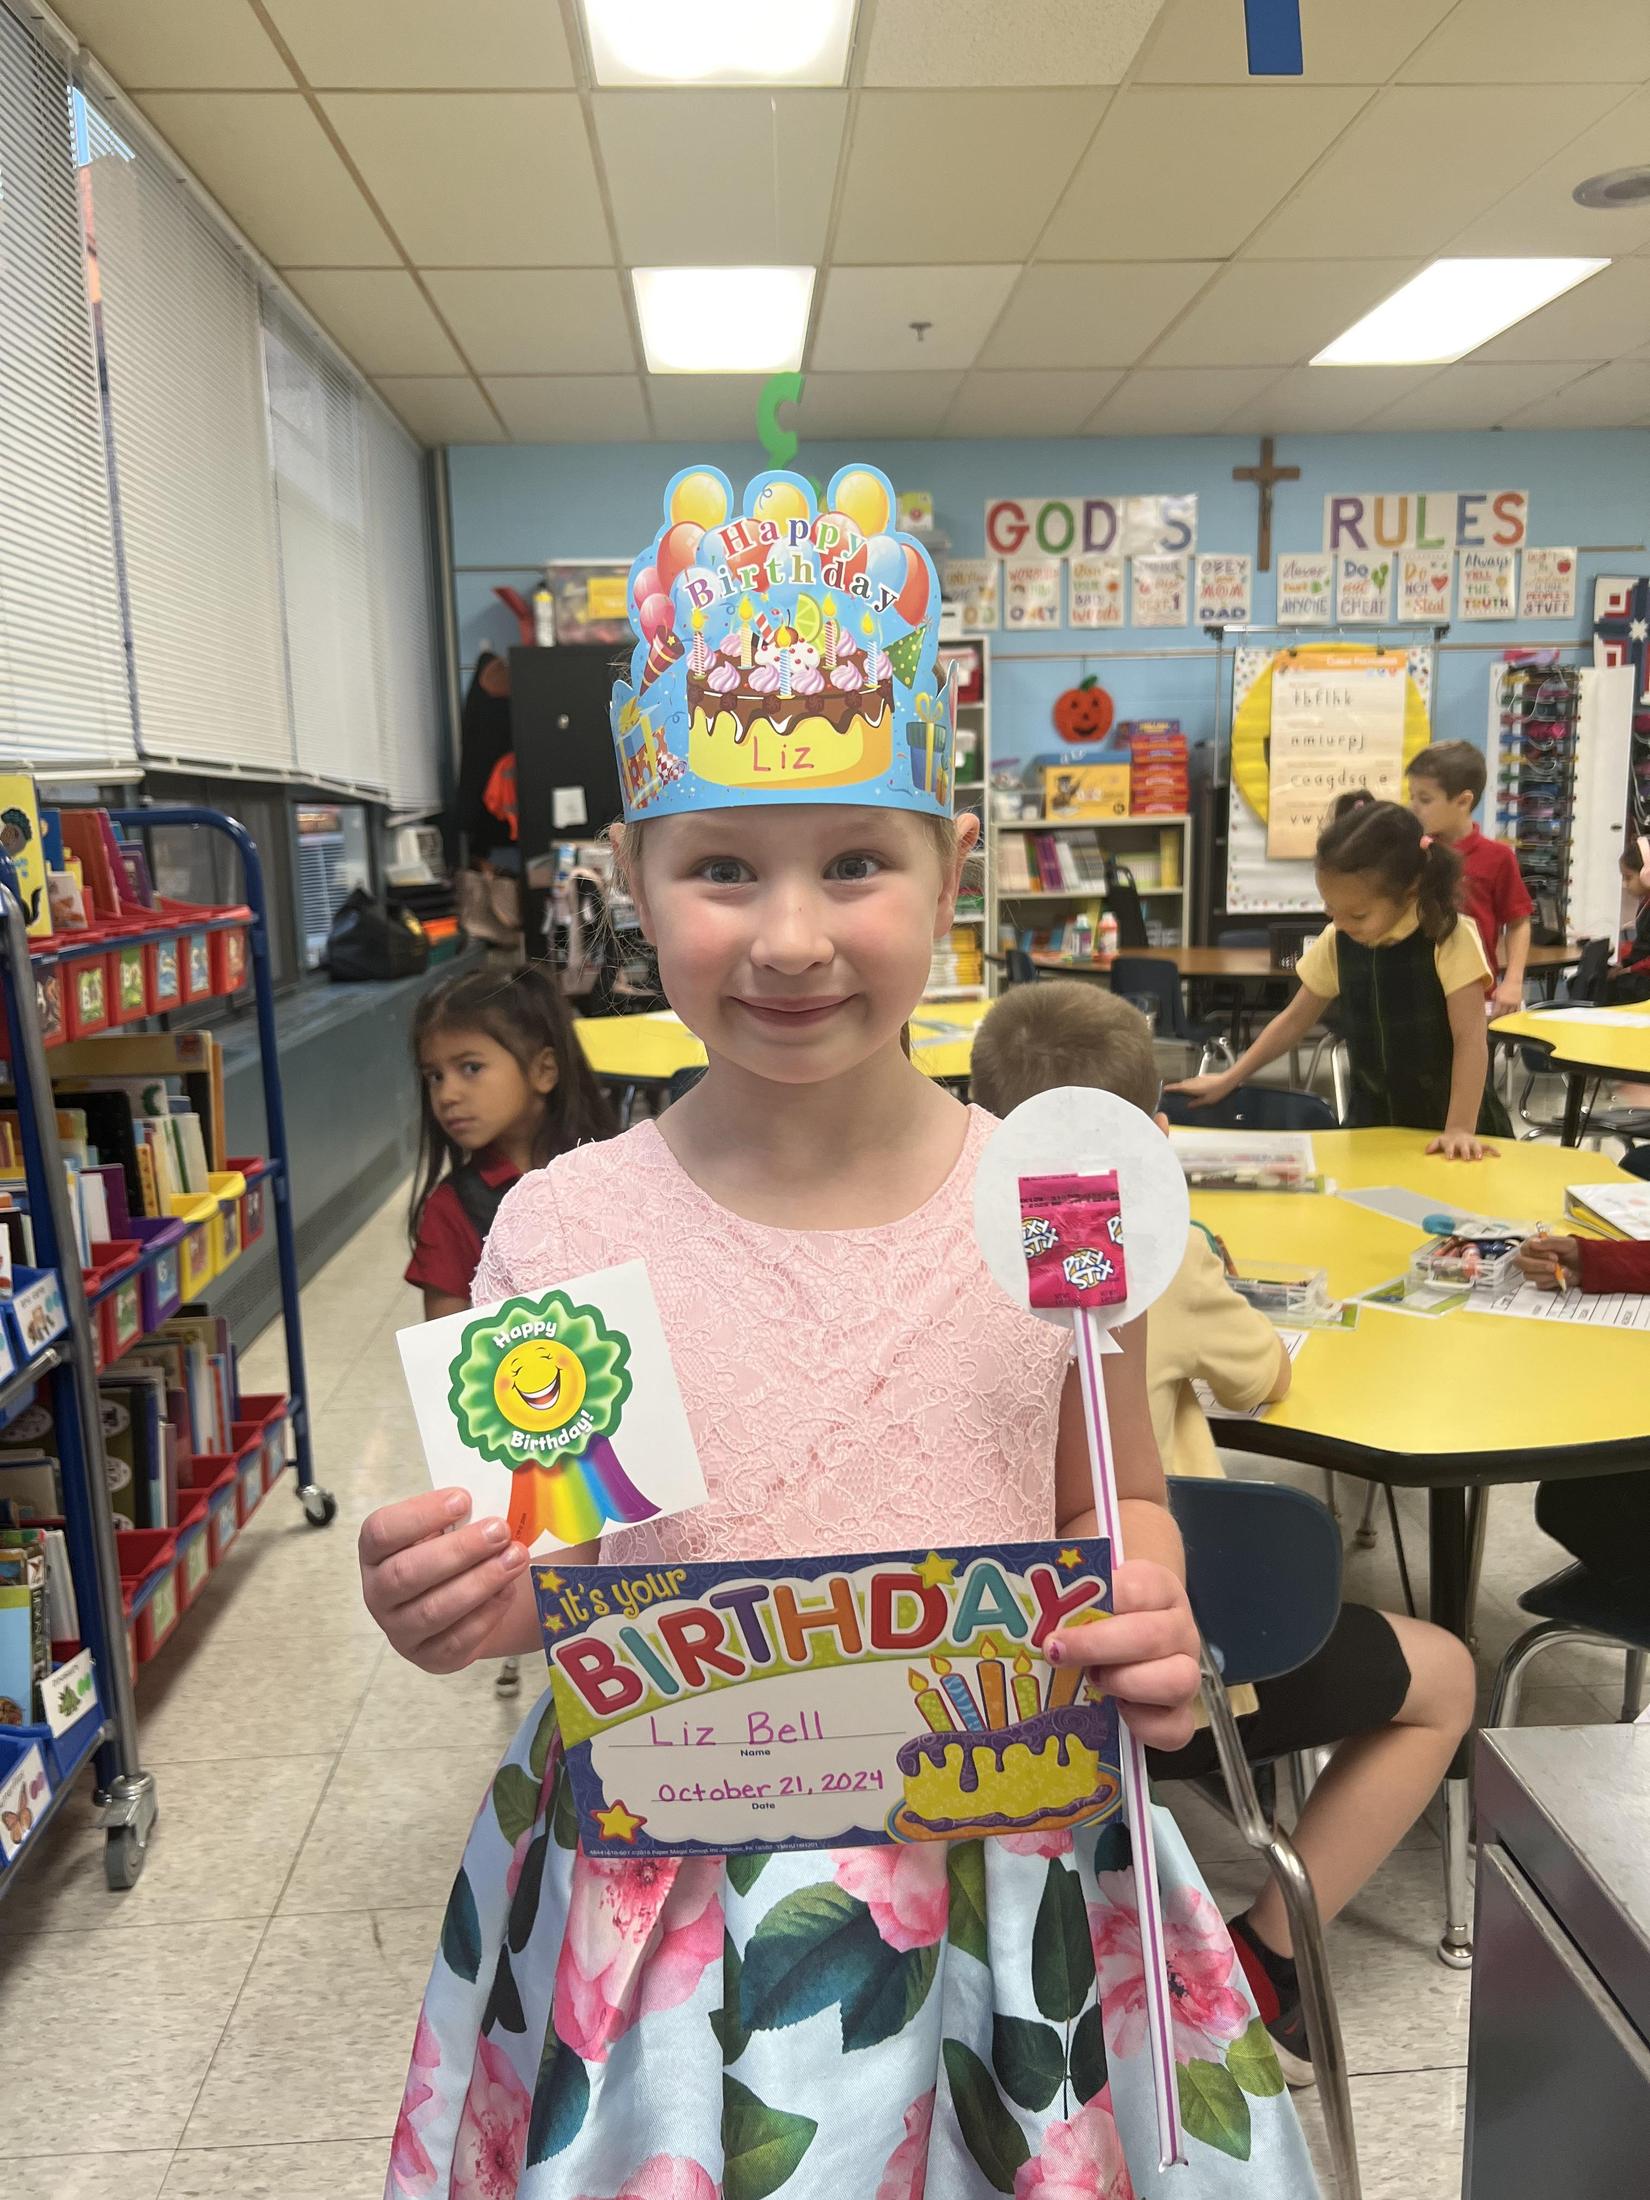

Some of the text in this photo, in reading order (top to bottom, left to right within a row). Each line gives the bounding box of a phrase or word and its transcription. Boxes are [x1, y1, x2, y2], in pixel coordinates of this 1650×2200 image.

[1329, 491, 1525, 550] RULES
[718, 518, 867, 558] Happy
[1201, 560, 1248, 575] OBEY
[1344, 560, 1369, 577] Do
[1465, 553, 1510, 571] Always
[684, 554, 900, 614] Birthday
[1202, 583, 1244, 598] MOM
[1467, 583, 1489, 595] THE
[1281, 597, 1329, 615] ANYONE
[1341, 600, 1385, 616] CHEAT
[1413, 597, 1445, 614] Steal
[1465, 597, 1509, 609] TRUTH
[1524, 602, 1569, 616] STUFF
[1200, 608, 1246, 619] DAD
[753, 735, 815, 772] Liz
[492, 1321, 557, 1349] Happy
[510, 1409, 595, 1451] Birthday!
[559, 1568, 687, 1627] It's your
[556, 1562, 1101, 1716] BIRTHDAY
[650, 1710, 824, 1747] Liz Bell
[740, 1749, 771, 1757] Name
[658, 1769, 884, 1803] October 21, 2024
[751, 1802, 776, 1810] Date
